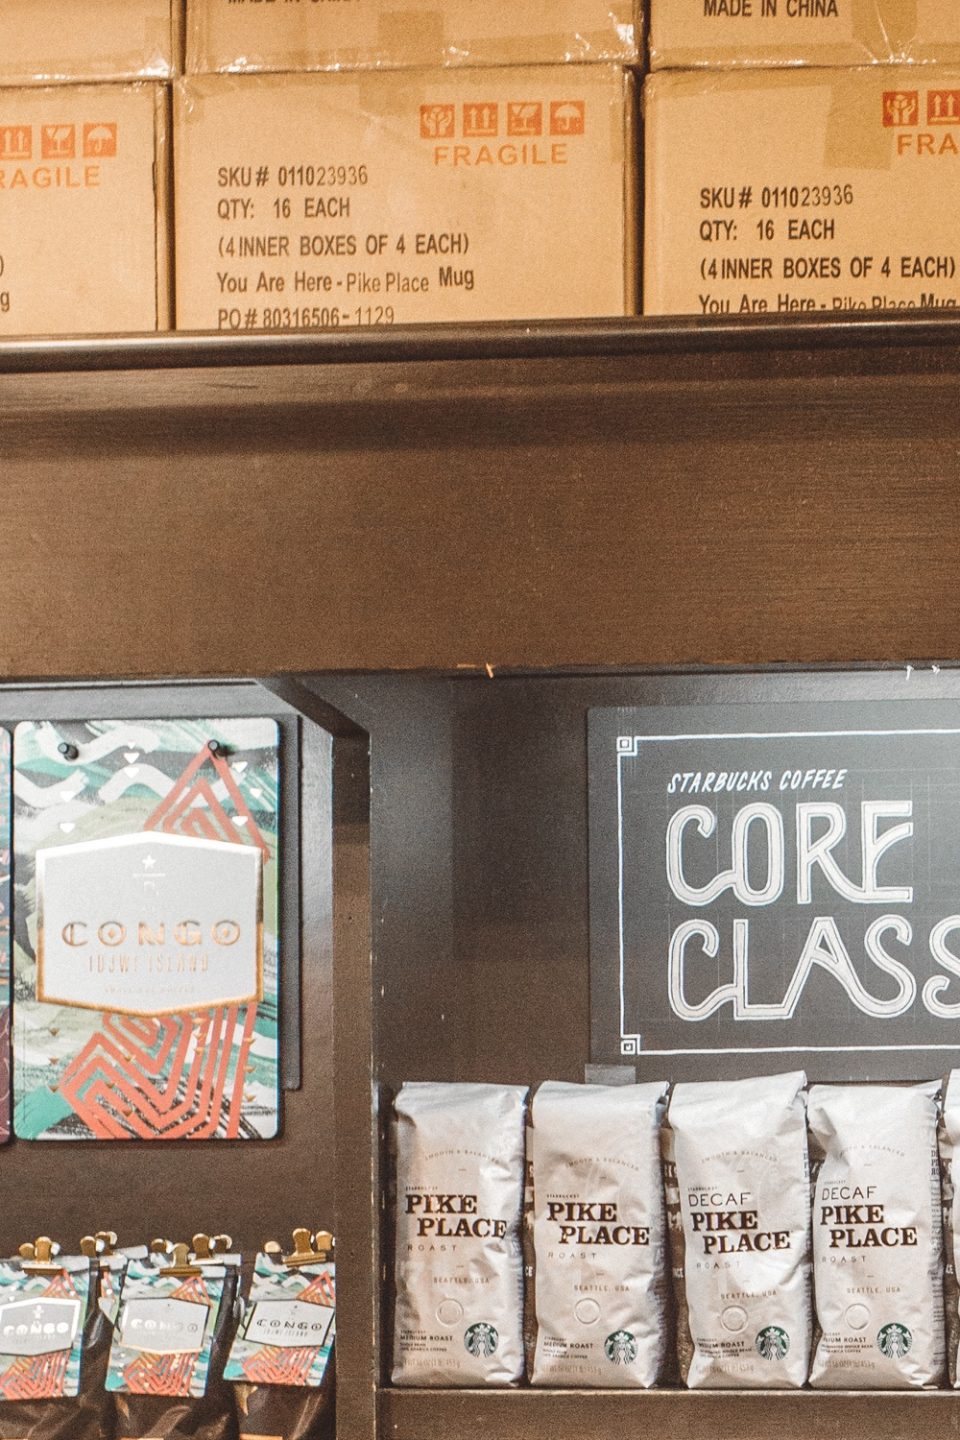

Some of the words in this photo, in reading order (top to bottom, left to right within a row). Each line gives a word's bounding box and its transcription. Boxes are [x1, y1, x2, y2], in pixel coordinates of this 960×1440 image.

[704, 0, 752, 17] MADE
[761, 0, 776, 17] IN
[787, 0, 839, 17] CHINA
[434, 142, 568, 166] FRAGILE
[278, 165, 368, 186] 011023936
[762, 184, 853, 208] 011023936
[217, 199, 255, 219] QTY:
[273, 198, 290, 218] 16
[304, 197, 350, 217] EACH
[700, 220, 737, 241] QTY:
[756, 219, 774, 240] 16
[788, 219, 835, 240] EACH
[300, 235, 356, 256] BOXES
[366, 234, 387, 255] OF
[396, 234, 406, 254] 4
[416, 233, 469, 255] EACH)
[784, 257, 841, 278] BOXES
[850, 257, 872, 278] OF
[881, 256, 890, 277] 4
[901, 256, 955, 278] EACH)
[217, 272, 247, 293] You
[256, 271, 284, 292] Are
[295, 271, 332, 291] Here
[347, 273, 380, 292] Pike
[386, 273, 428, 291] Place
[439, 267, 474, 289] Mug
[699, 294, 729, 314] You
[739, 294, 768, 313] Are
[778, 293, 815, 312] Here
[667, 771, 772, 794] STARBUCKS
[779, 769, 848, 791] COFFEE
[666, 800, 913, 906] CORE
[61, 919, 240, 947] CONGO
[688, 1191, 751, 1207] DECAF
[821, 1186, 877, 1201] DECAF
[405, 1194, 477, 1215] PIKE
[547, 1202, 617, 1222] PIKE
[820, 1204, 884, 1225] PIKE
[417, 1218, 507, 1239] PLACE
[690, 1210, 758, 1232] PIKE
[558, 1226, 650, 1246] PLACE
[703, 1231, 791, 1255] PLACE
[829, 1227, 918, 1248] PLACE
[407, 1244, 457, 1252] ROAST
[821, 1255, 867, 1263] ROAST
[256, 1318, 323, 1331] CONGO
